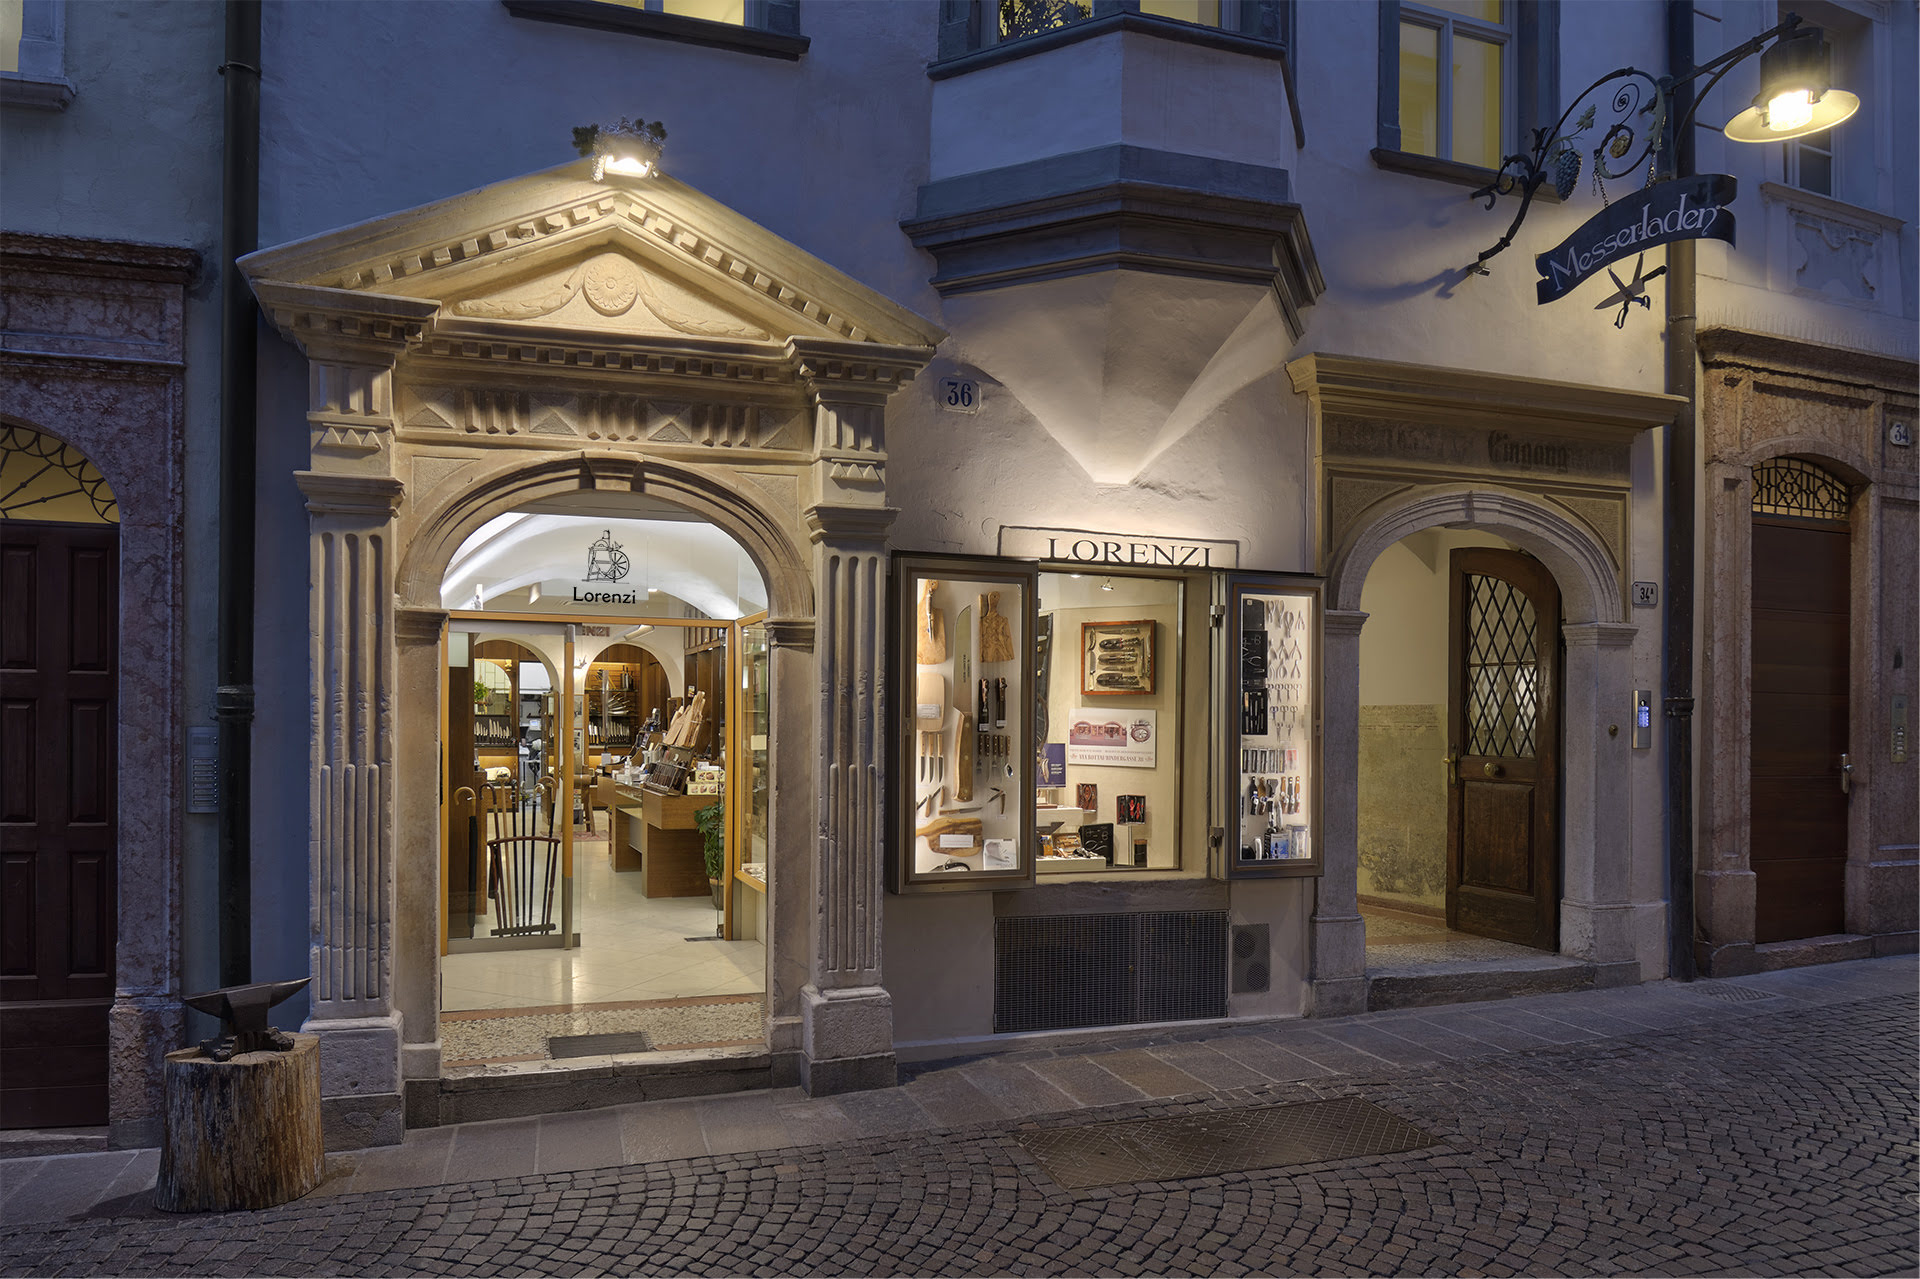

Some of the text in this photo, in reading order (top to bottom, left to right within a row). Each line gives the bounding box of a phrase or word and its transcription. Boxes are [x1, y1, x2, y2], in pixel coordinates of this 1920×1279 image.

[1550, 193, 1721, 291] Messerladen
[947, 381, 972, 407] 36
[1048, 538, 1211, 567] LORENZI
[573, 586, 636, 604] Lorenzi
